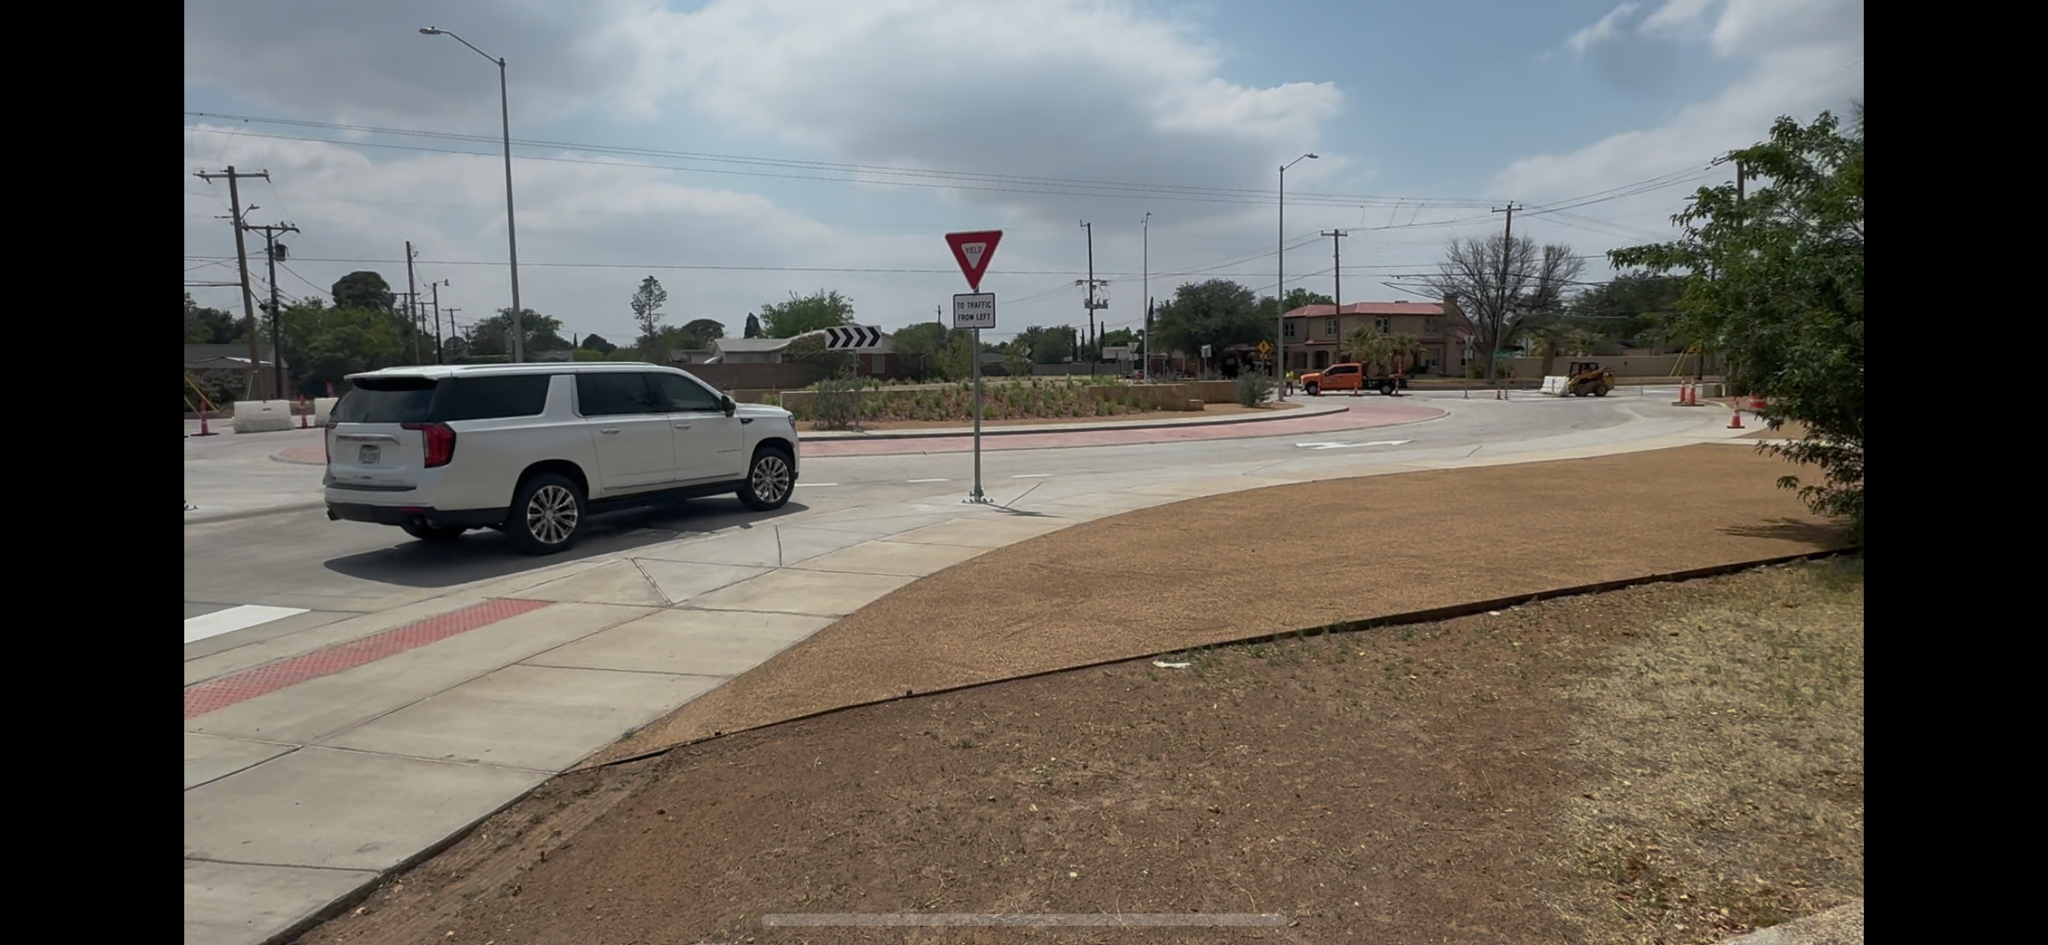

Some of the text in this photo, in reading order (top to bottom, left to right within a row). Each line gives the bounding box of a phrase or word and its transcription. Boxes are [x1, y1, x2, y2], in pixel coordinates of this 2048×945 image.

[965, 246, 982, 254] YIELD
[967, 301, 991, 309] TRAFFIC
[958, 313, 991, 321] FROM LEFT
